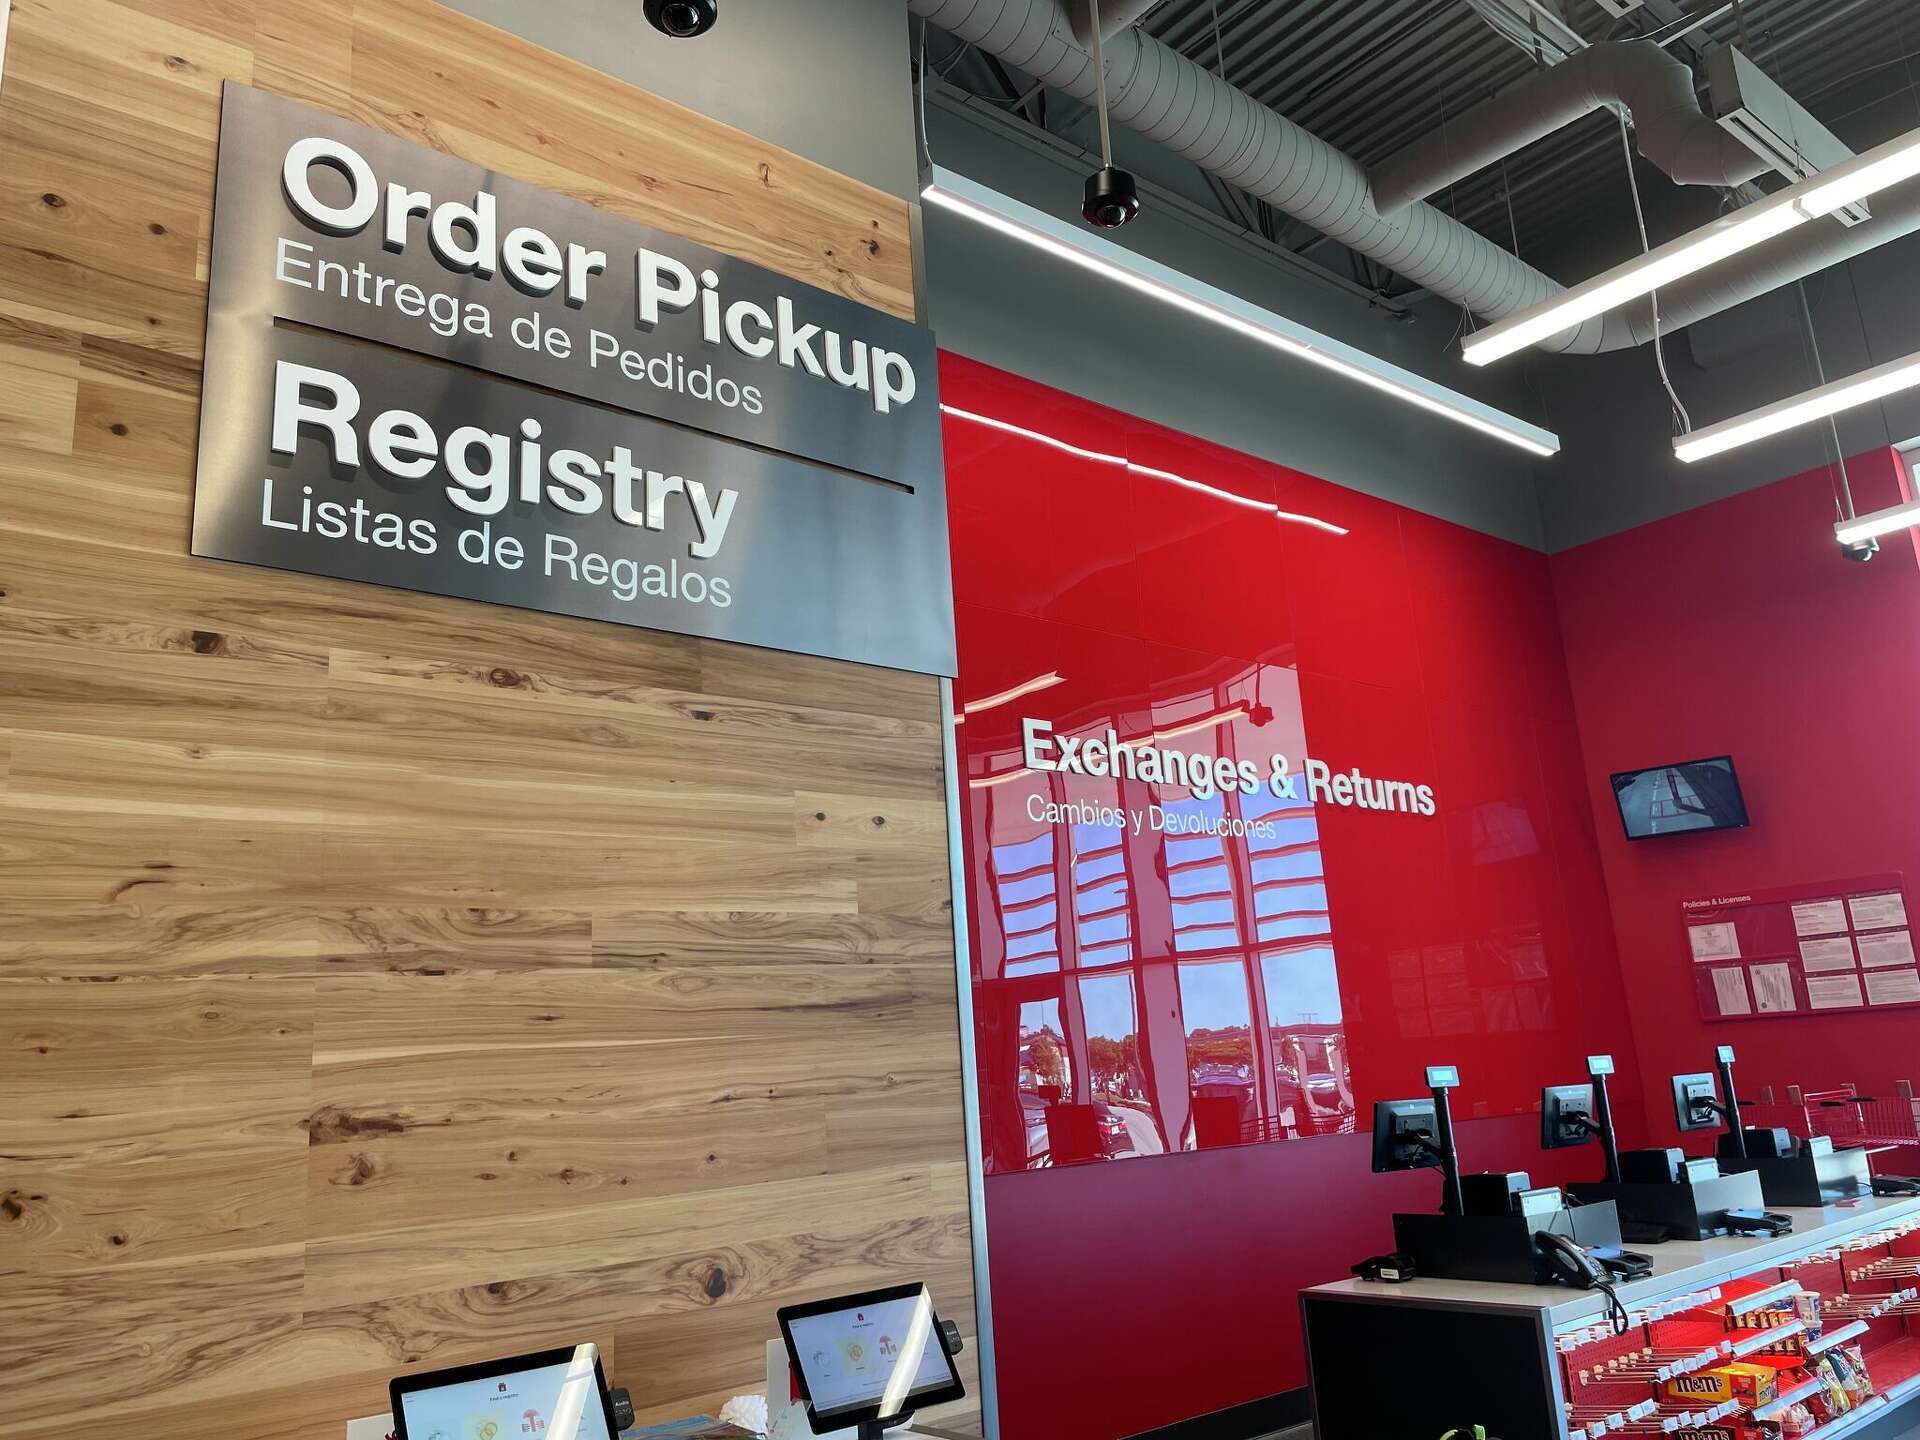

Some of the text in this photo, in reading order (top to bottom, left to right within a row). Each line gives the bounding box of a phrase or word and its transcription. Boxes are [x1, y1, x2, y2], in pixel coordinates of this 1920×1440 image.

[275, 237, 764, 415] Entrega de Pedidos
[282, 137, 918, 414] Order Pickup
[271, 360, 738, 558] Registry
[262, 479, 734, 608] Listas de Regalos
[1022, 717, 1437, 816] Exchanges & Returns
[1026, 794, 1277, 840] Cambios y Devoluciones
[1682, 895, 1752, 909] Policies & Licenses
